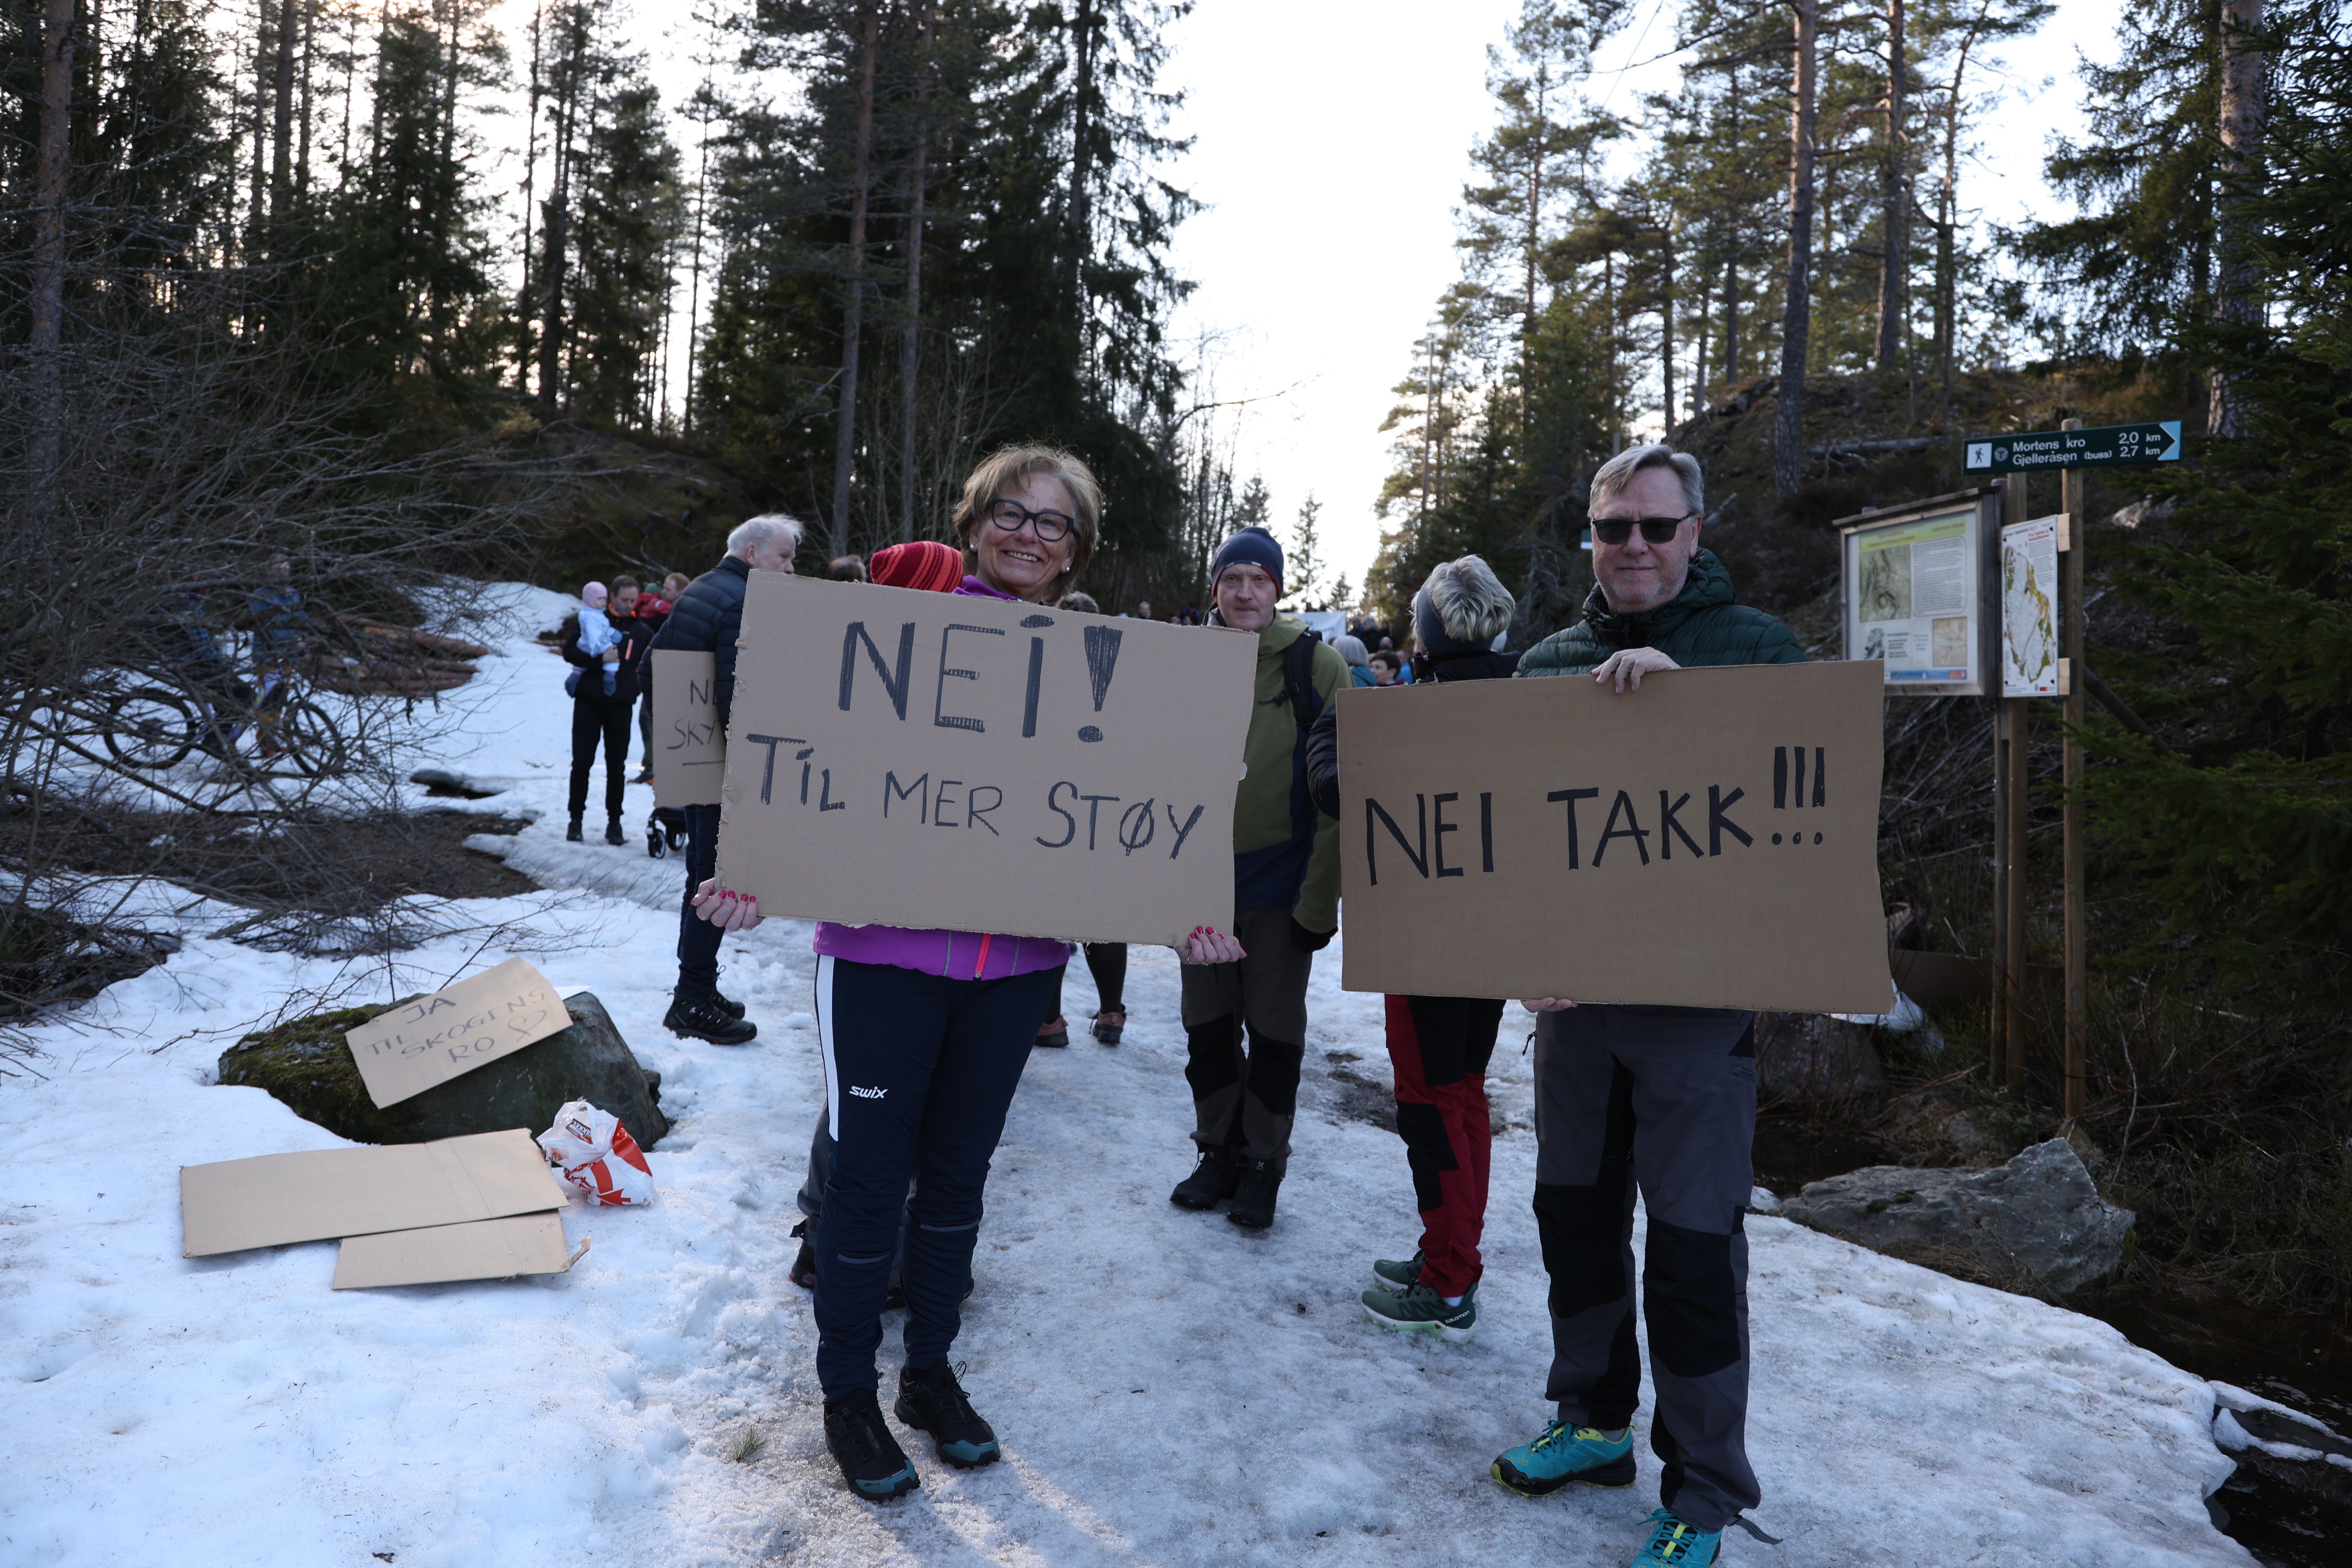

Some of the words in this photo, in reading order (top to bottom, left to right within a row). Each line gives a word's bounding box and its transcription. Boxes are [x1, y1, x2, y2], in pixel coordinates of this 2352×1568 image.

[2013, 441, 2060, 452] Mortens
[2066, 438, 2086, 448] kro
[2119, 432, 2139, 445] 2,0
[2146, 433, 2161, 442] km
[2013, 450, 2077, 467] Gjelleråsen
[2084, 450, 2112, 460] (buss)
[2120, 445, 2139, 457] 2,7
[2145, 447, 2160, 456] km
[667, 719, 719, 750] SKY
[884, 770, 1000, 837] MER
[1033, 780, 1205, 861] STØY
[1365, 791, 1494, 887] NEI
[1547, 746, 1826, 871] TAKK!!!
[401, 987, 545, 1059] SKOGENS
[402, 997, 457, 1024] JA
[448, 1036, 495, 1063] RO
